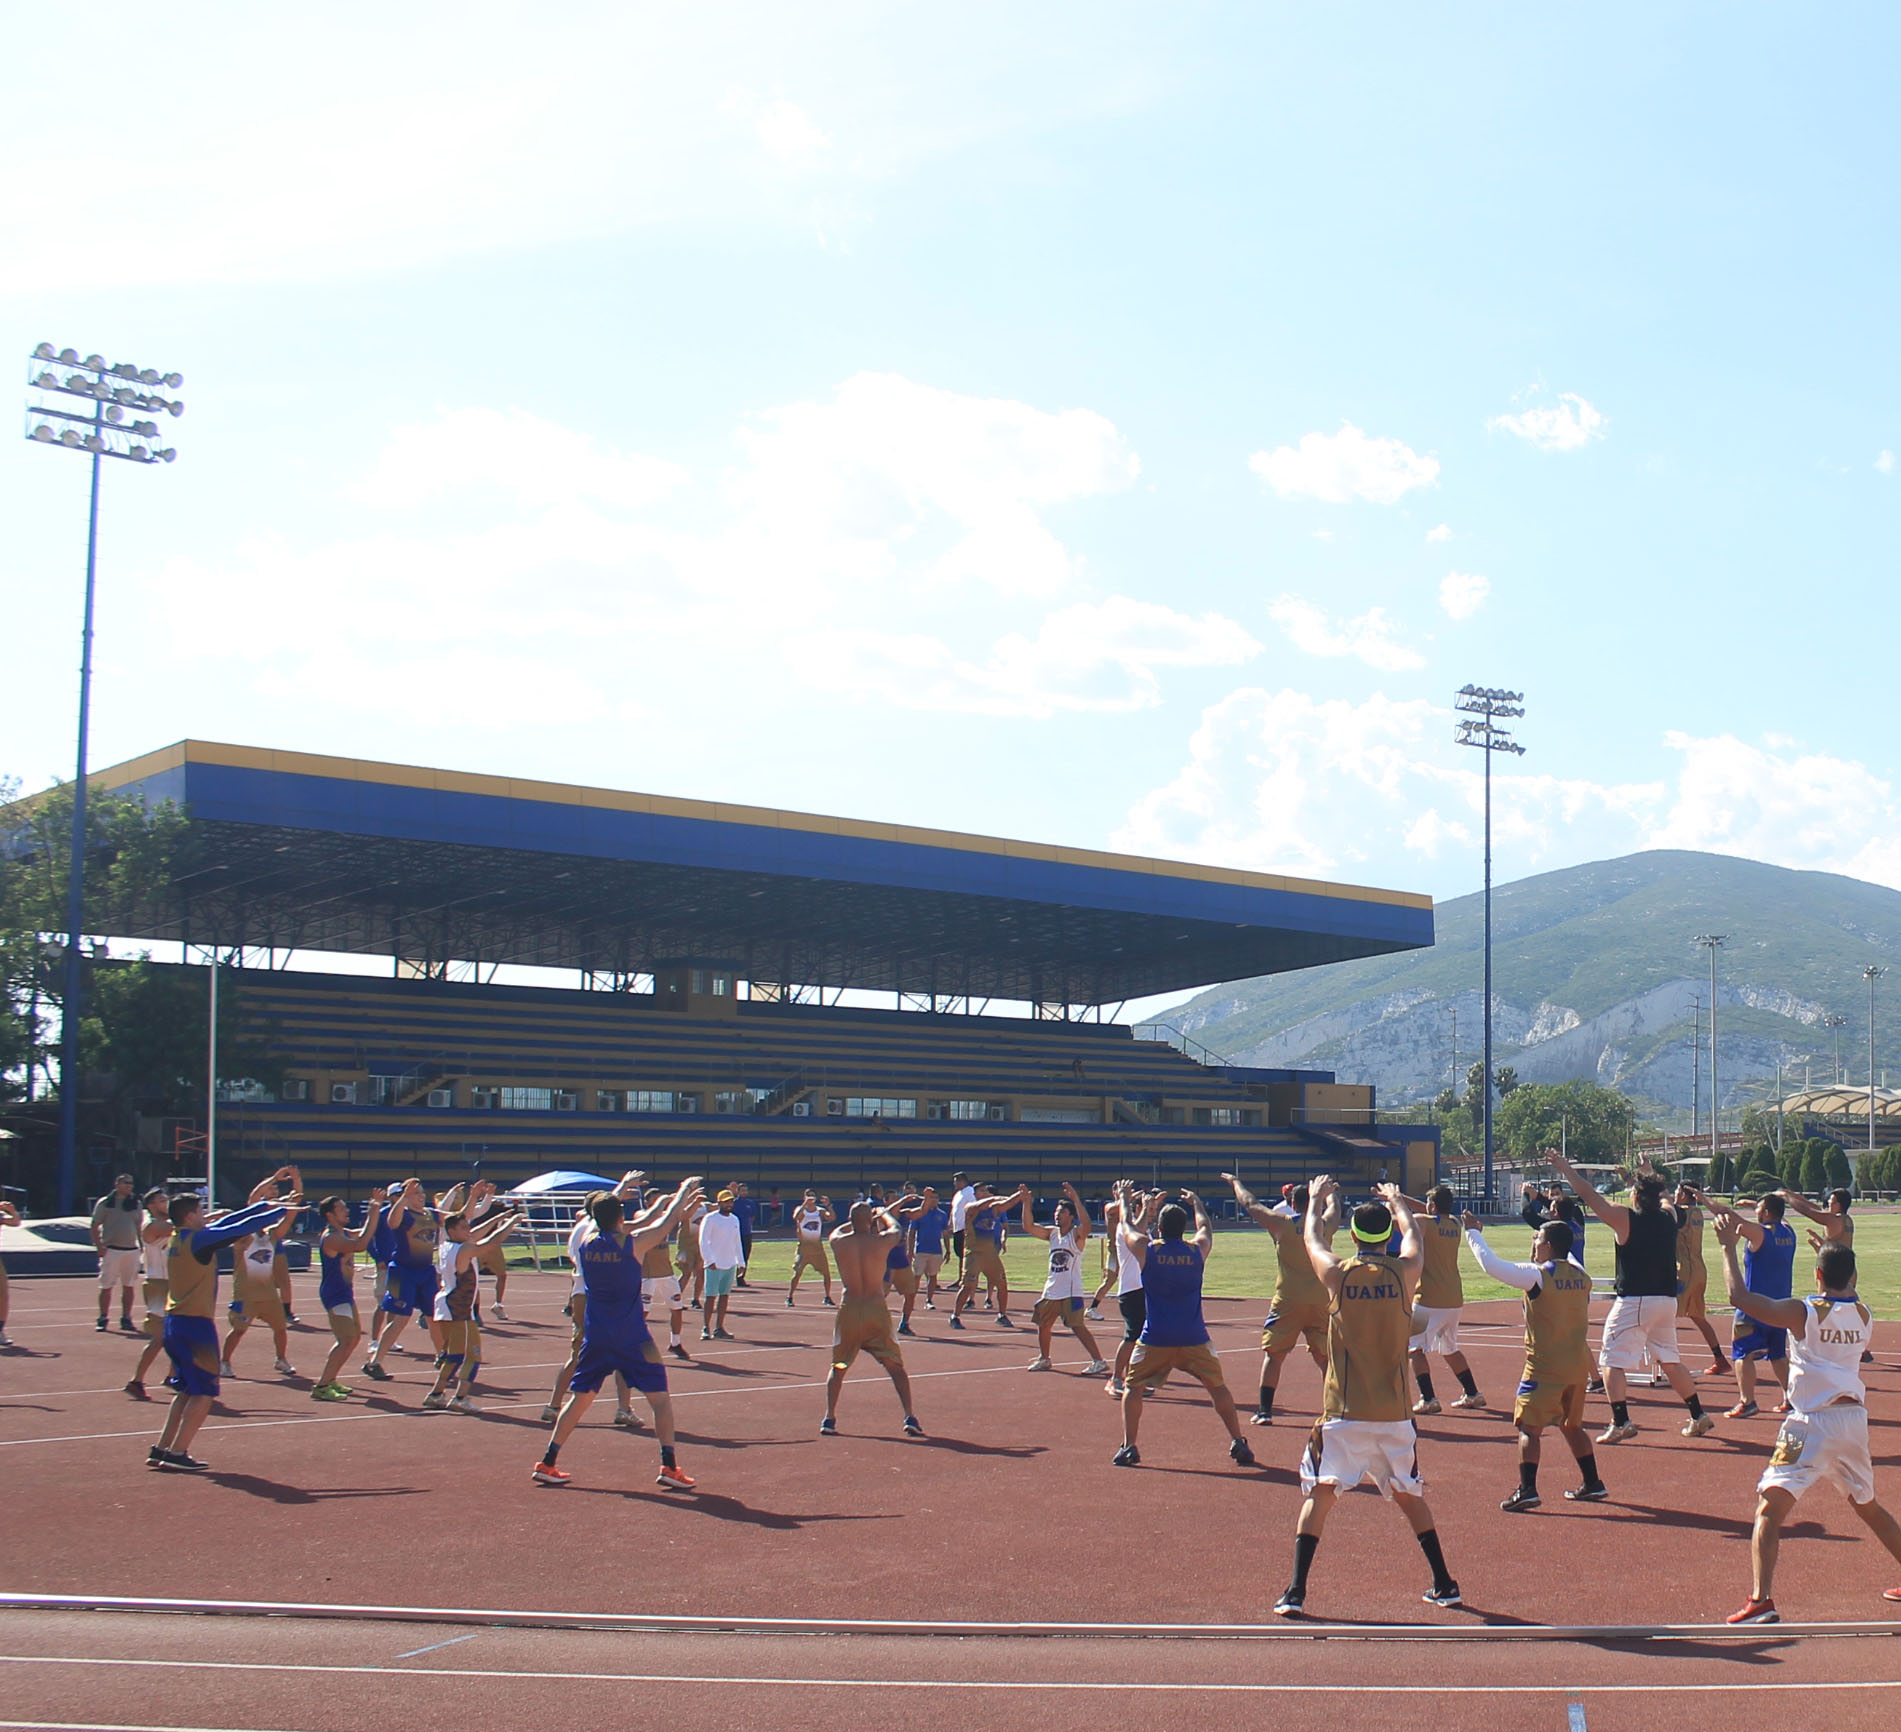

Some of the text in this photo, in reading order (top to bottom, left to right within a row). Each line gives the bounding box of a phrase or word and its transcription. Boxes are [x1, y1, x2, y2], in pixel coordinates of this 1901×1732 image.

[585, 1251, 622, 1262] UANL
[1157, 1255, 1194, 1265] UANL
[1555, 1279, 1586, 1290] UANL
[1345, 1284, 1398, 1300] UANL
